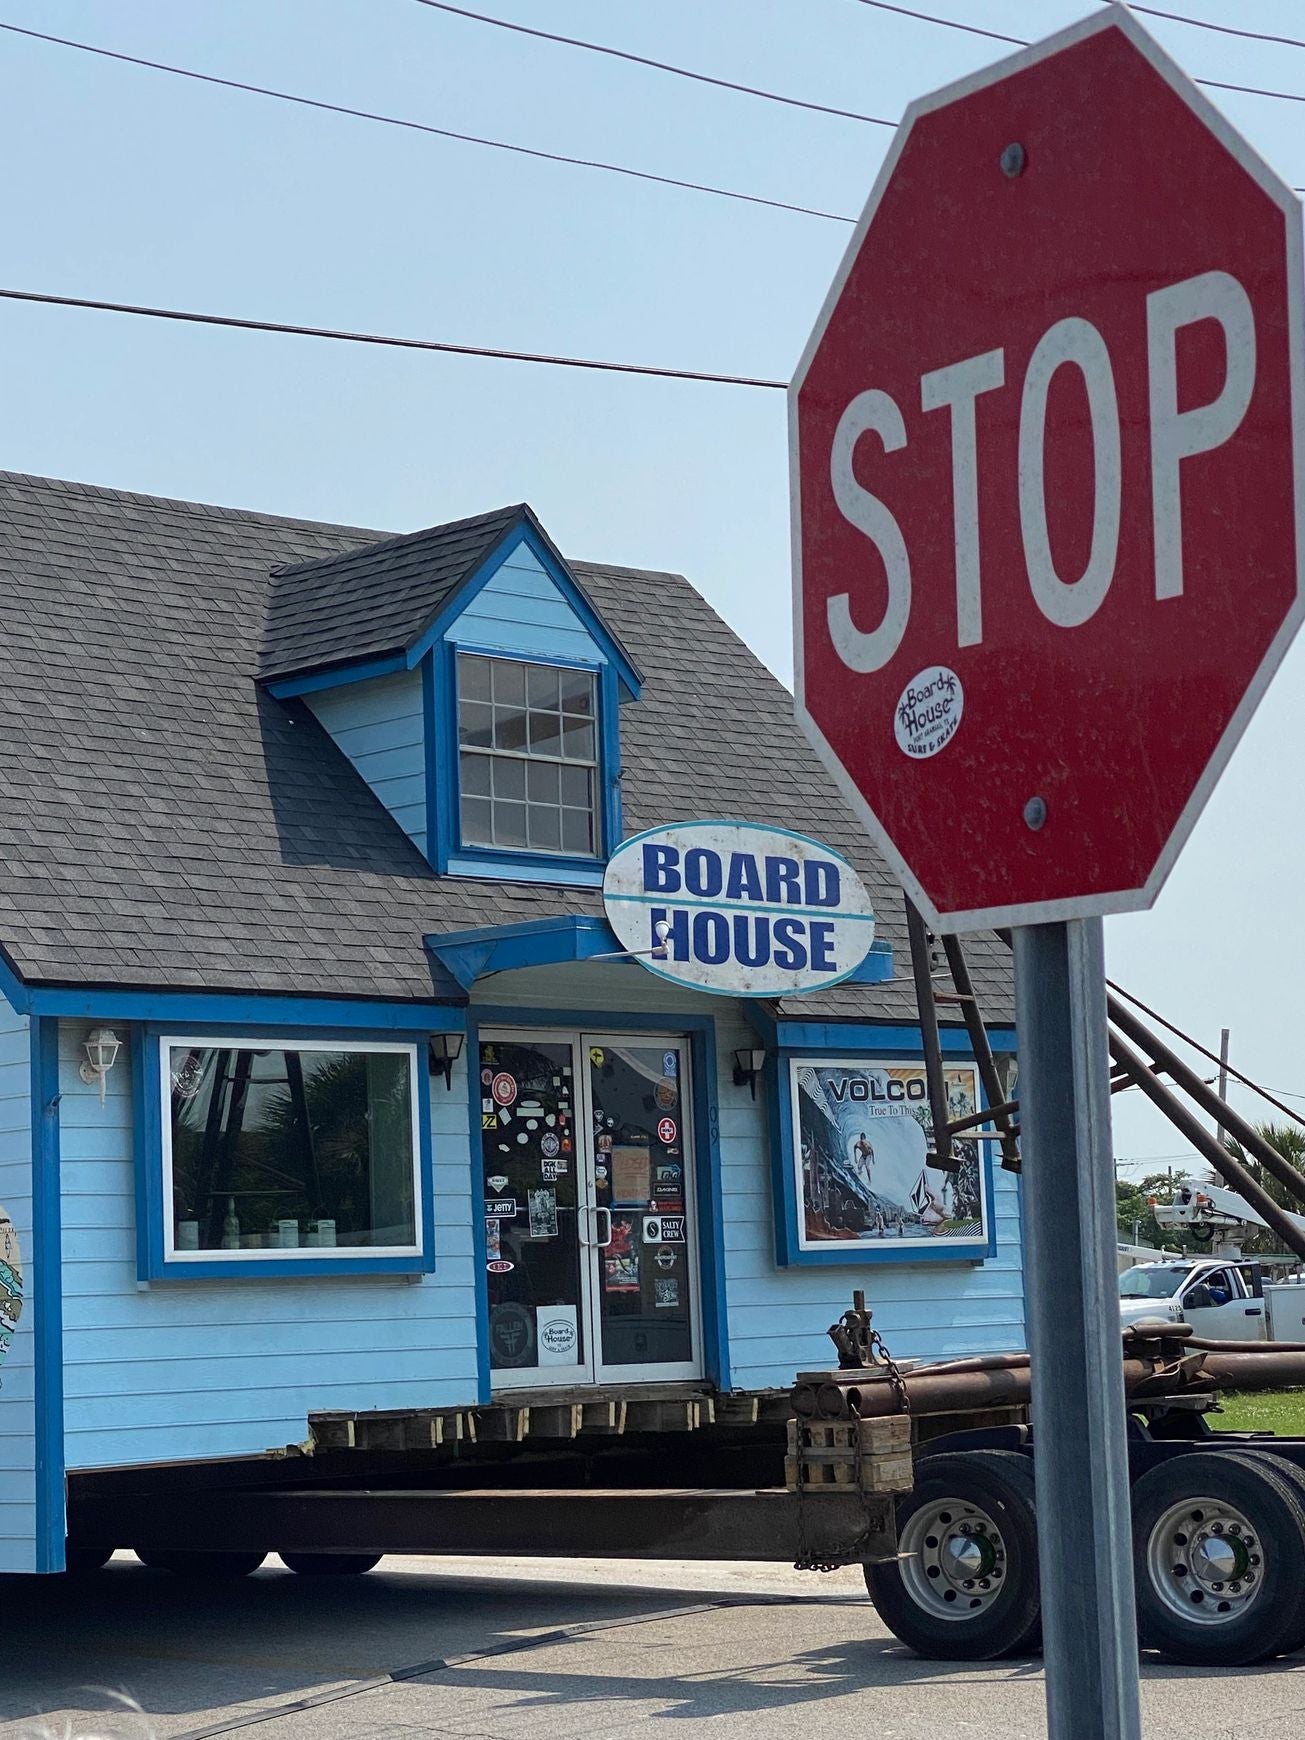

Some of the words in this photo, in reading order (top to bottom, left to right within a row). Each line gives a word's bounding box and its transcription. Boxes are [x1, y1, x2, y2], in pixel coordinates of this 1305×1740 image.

[827, 270, 1257, 674] STOP
[906, 671, 945, 710] Board
[904, 697, 954, 737] House
[907, 743, 927, 754] SURF
[642, 843, 841, 907] BOARD
[650, 907, 837, 972] HOUSE
[827, 1078, 949, 1102] VOLCO
[868, 1105, 887, 1116] True
[888, 1105, 898, 1116] To
[900, 1104, 916, 1116] This
[662, 1221, 680, 1230] SALTY
[662, 1230, 679, 1238] CREW
[546, 1335, 573, 1343] House
[549, 1327, 569, 1335] Board
